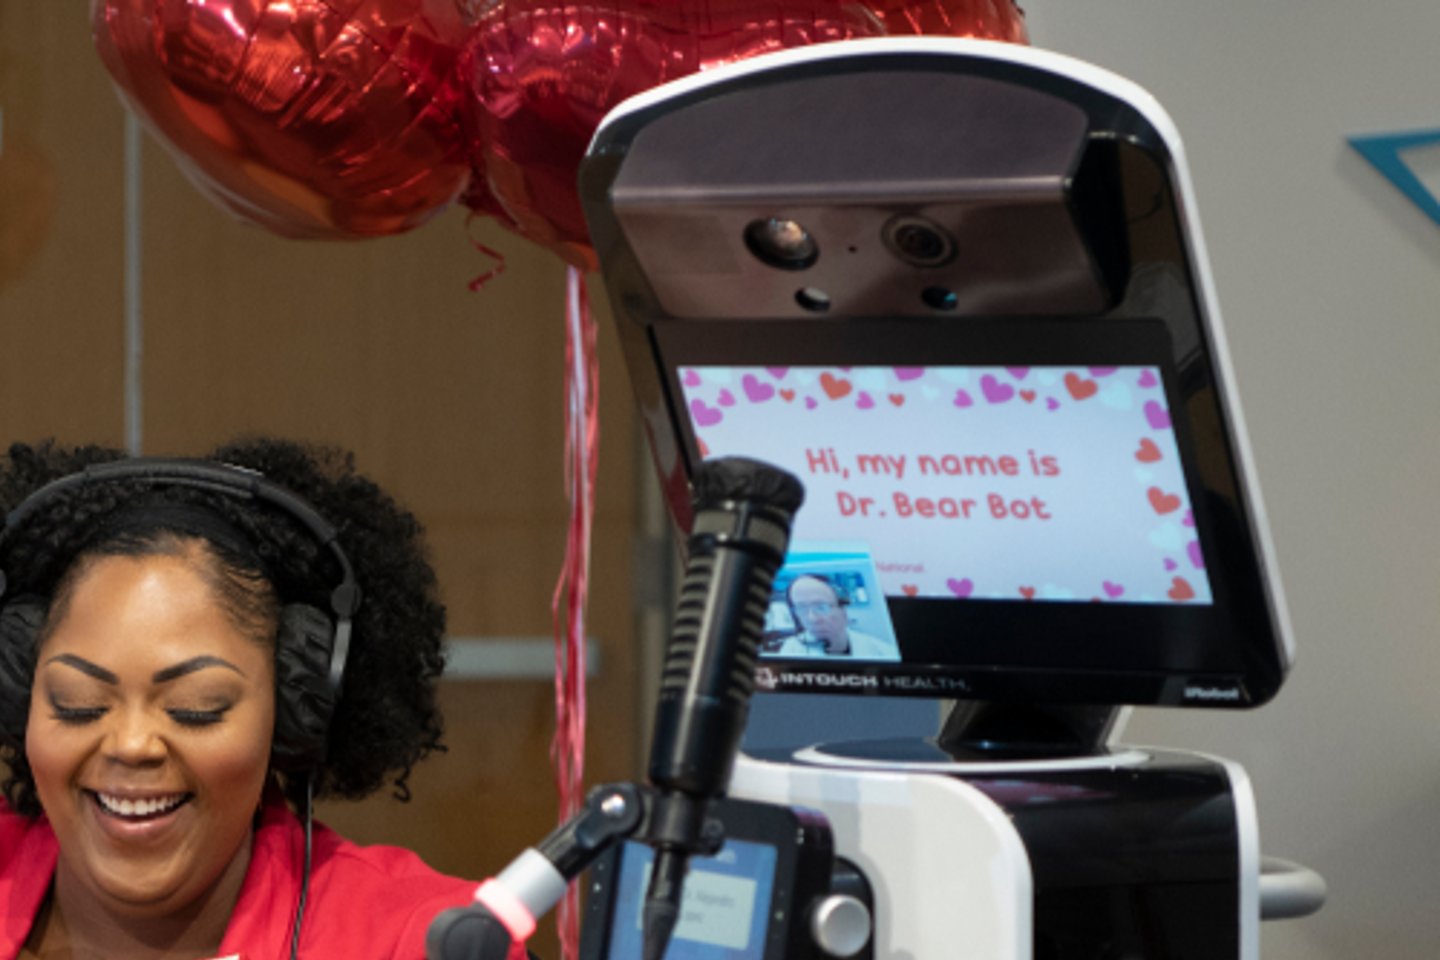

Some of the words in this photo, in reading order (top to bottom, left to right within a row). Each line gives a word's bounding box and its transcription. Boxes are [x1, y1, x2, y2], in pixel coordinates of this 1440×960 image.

[805, 448, 850, 479] Hi,
[857, 454, 906, 479] my
[917, 453, 1019, 476] name
[1025, 449, 1060, 476] is
[836, 491, 886, 517] Dr.
[892, 491, 976, 517] Bear
[987, 492, 1052, 519] Bot
[780, 672, 879, 688] INTOUCH
